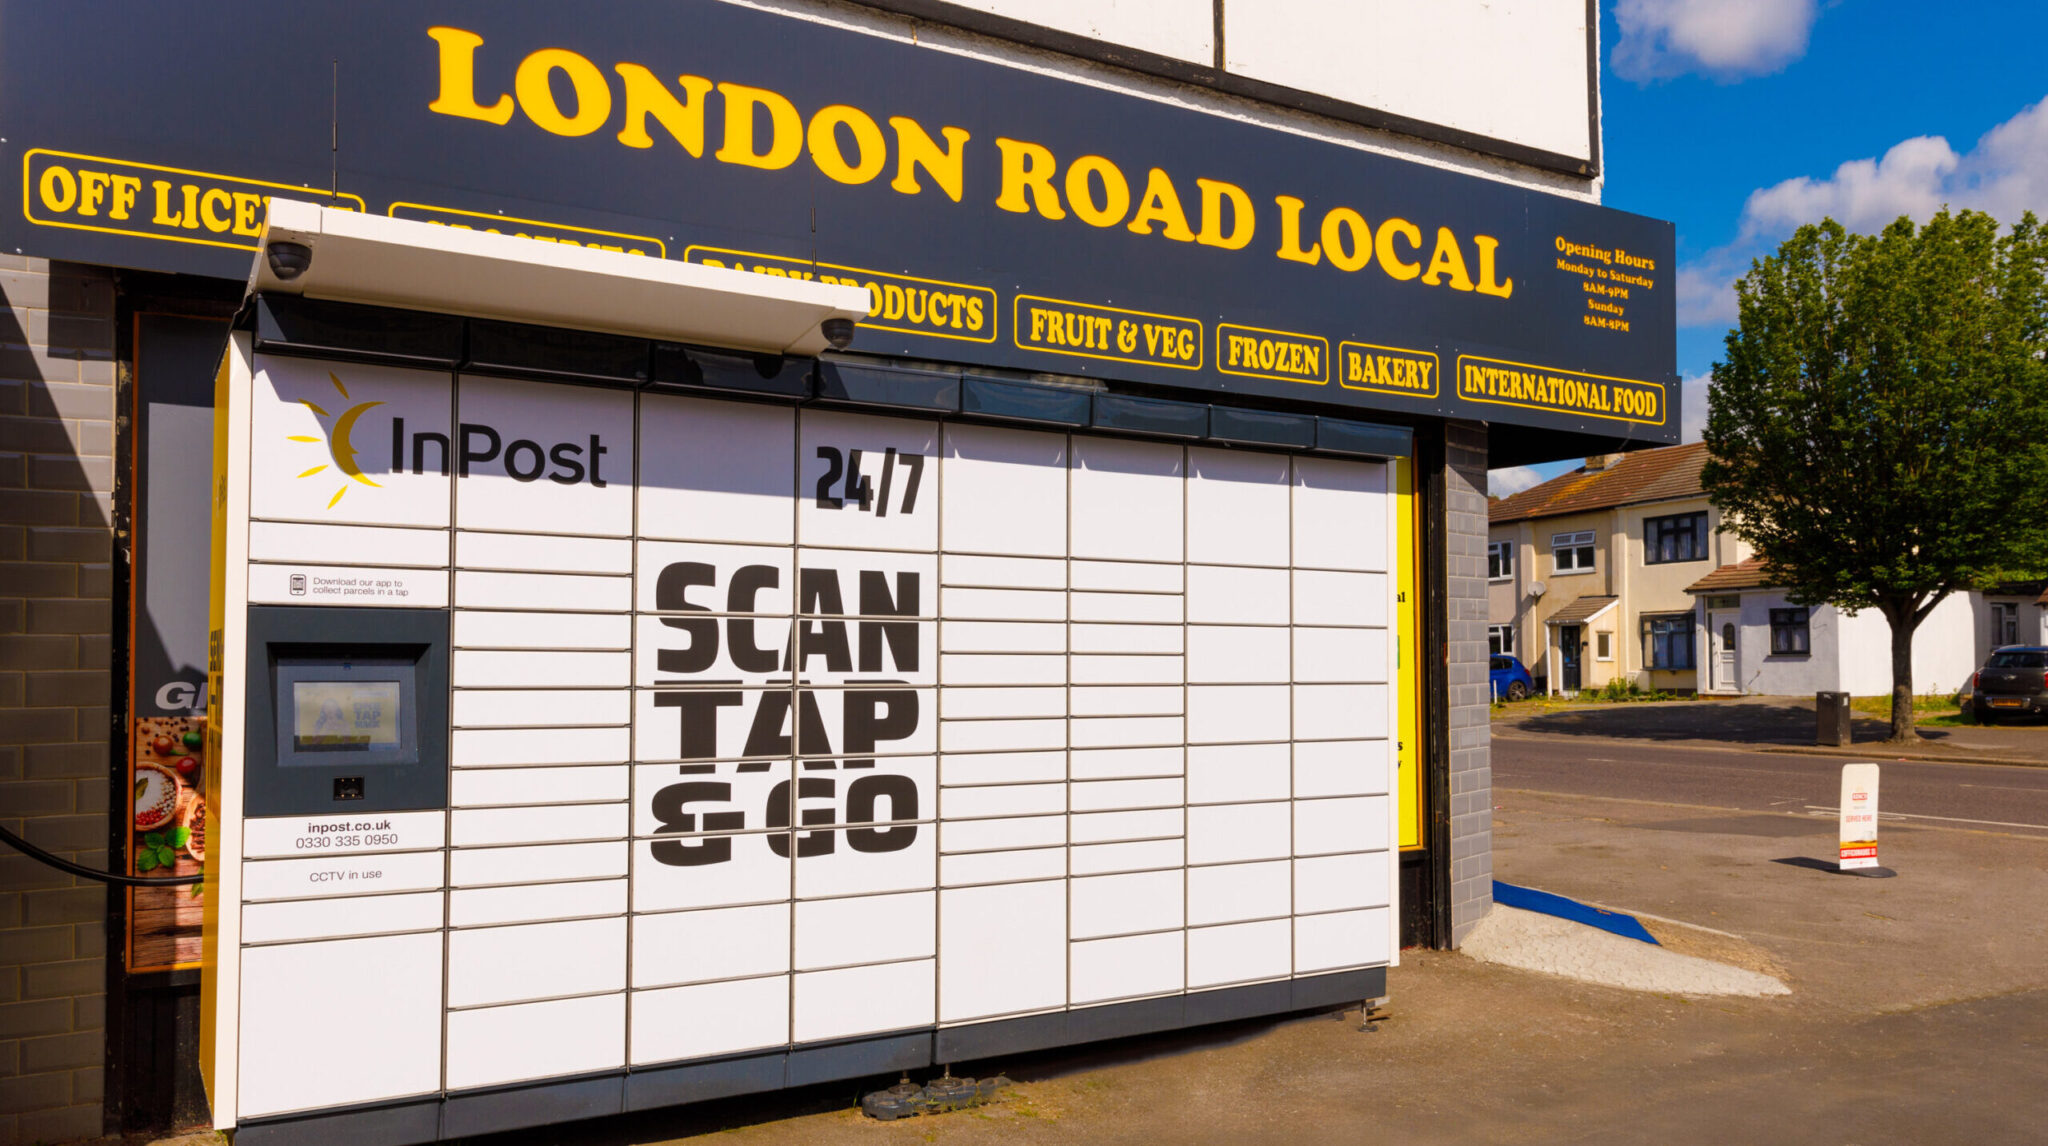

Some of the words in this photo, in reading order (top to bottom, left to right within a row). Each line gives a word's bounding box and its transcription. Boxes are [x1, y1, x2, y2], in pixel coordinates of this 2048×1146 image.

[427, 25, 970, 203] LONDON
[996, 136, 1256, 251] ROAD
[1275, 194, 1513, 300] LOCAL
[39, 165, 142, 220] OFF
[1555, 235, 1612, 265] Opening
[1614, 248, 1655, 271] Hours
[1556, 258, 1595, 278] Monday
[1596, 267, 1608, 279] to
[1609, 269, 1654, 290] Saturday
[1583, 281, 1629, 300] 8AM-9PM
[1587, 298, 1625, 317] Sunday
[1030, 307, 1112, 351] FRUIT
[1117, 319, 1139, 354] &
[1143, 323, 1196, 361] VEG
[1228, 334, 1321, 376] FROZEN
[1348, 351, 1433, 391] BAKERY
[1463, 364, 1612, 412] INTERNATIONAL
[1613, 386, 1657, 418] FOOD
[392, 416, 608, 488] InPost
[815, 446, 925, 517] 24/7
[313, 577, 356, 586] Download
[376, 580, 392, 588] app
[394, 580, 403, 588] to
[313, 586, 341, 594] collect
[343, 587, 375, 596] parcels
[395, 588, 409, 597] tap
[656, 561, 920, 674] SCAN
[653, 679, 919, 775] TAP
[296, 836, 331, 849] 0330
[335, 835, 360, 847] 335
[364, 833, 398, 846] 0950
[308, 820, 391, 835] inpost.co.uk
[650, 780, 745, 867] &
[765, 774, 919, 859] GO
[309, 870, 346, 882] CCTV
[348, 870, 358, 880] in
[362, 870, 382, 880] use
